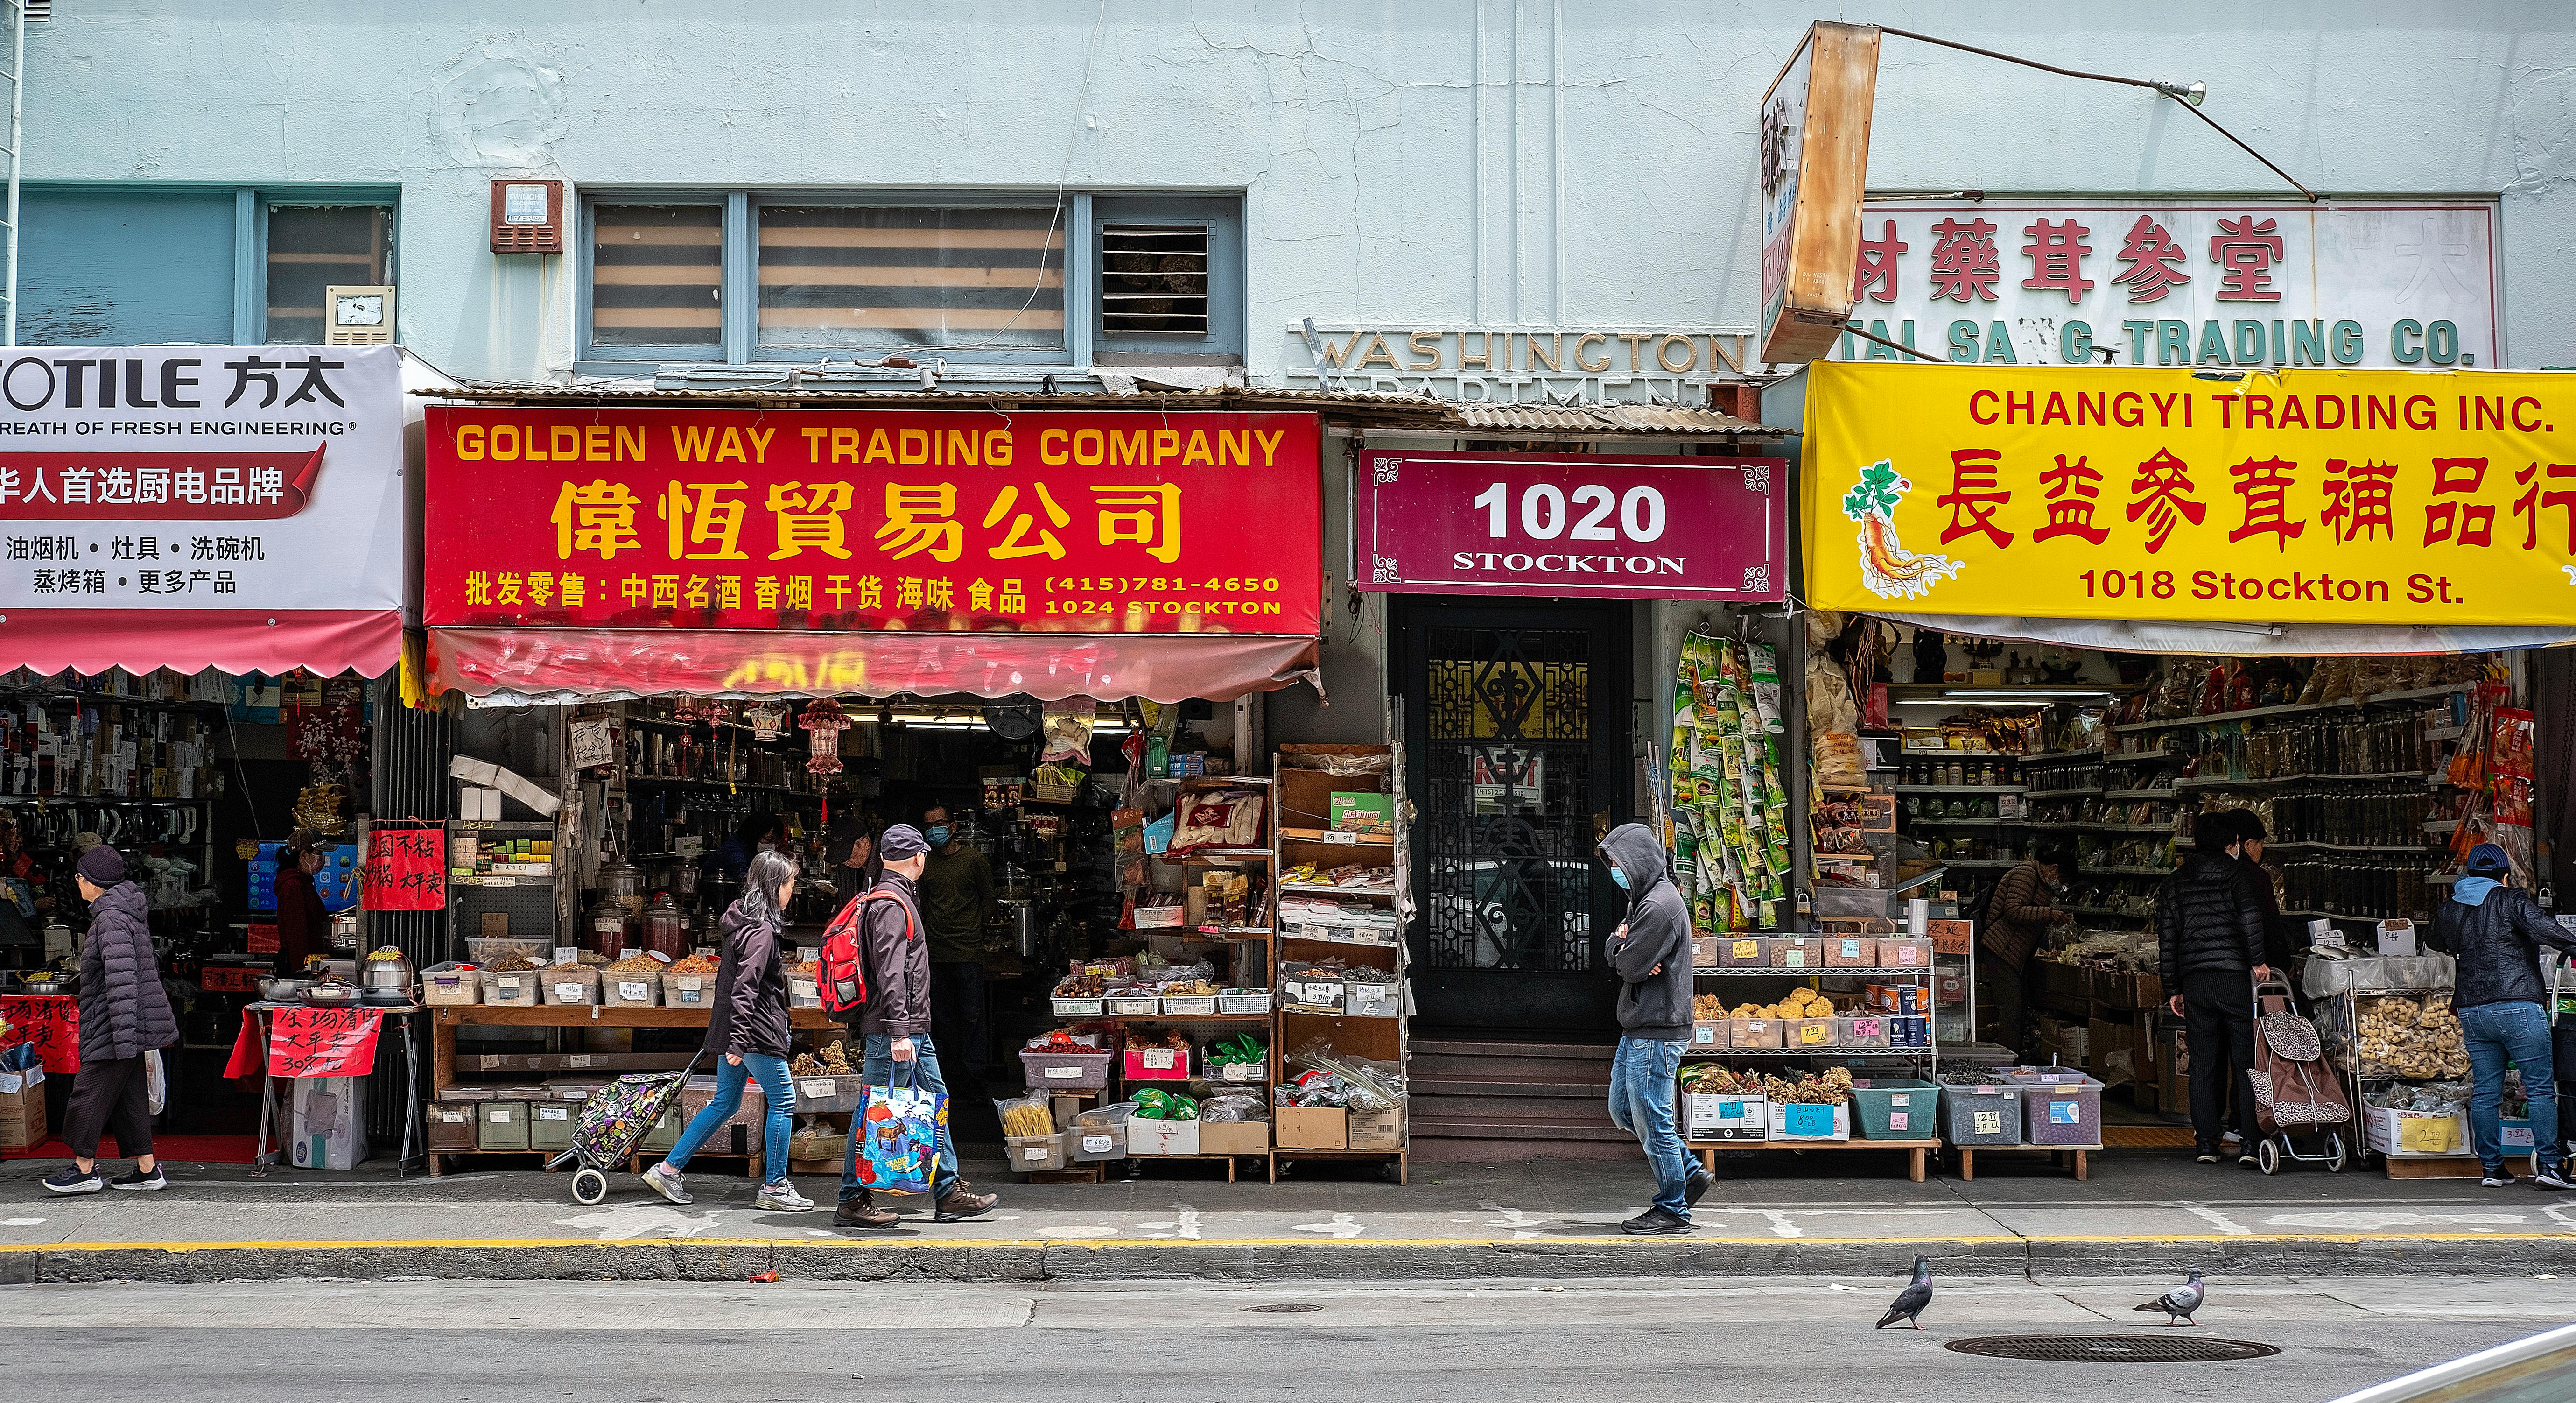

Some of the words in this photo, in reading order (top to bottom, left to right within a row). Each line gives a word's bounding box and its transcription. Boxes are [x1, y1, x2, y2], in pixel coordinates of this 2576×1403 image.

[1299, 331, 1744, 372] WASHINGTON
[1948, 319, 2093, 365] SAG
[2122, 318, 2364, 365] TRADING
[2391, 318, 2475, 364] CO.
[0, 356, 201, 411] OTILE
[224, 355, 345, 409] 方太
[75, 422, 104, 435] OF
[111, 422, 182, 435] FRESH
[1969, 389, 2192, 428] CHANGYI
[2212, 394, 2436, 430] TRADING
[2459, 395, 2554, 432] INC.
[456, 424, 646, 462] GOLDEN
[672, 425, 776, 463] WAY
[802, 427, 1014, 466] TRADING
[1040, 429, 1285, 467] COMPANY
[1474, 483, 1666, 543] 1020
[1453, 551, 1686, 575] STOCKTON
[1044, 576, 1280, 594] (415)781-4650
[2079, 569, 2176, 599] 1018
[2191, 570, 2389, 602] Stockton
[2406, 573, 2464, 605] St.
[1045, 600, 1114, 614] 1024
[1126, 601, 1281, 615] STOCKTON
